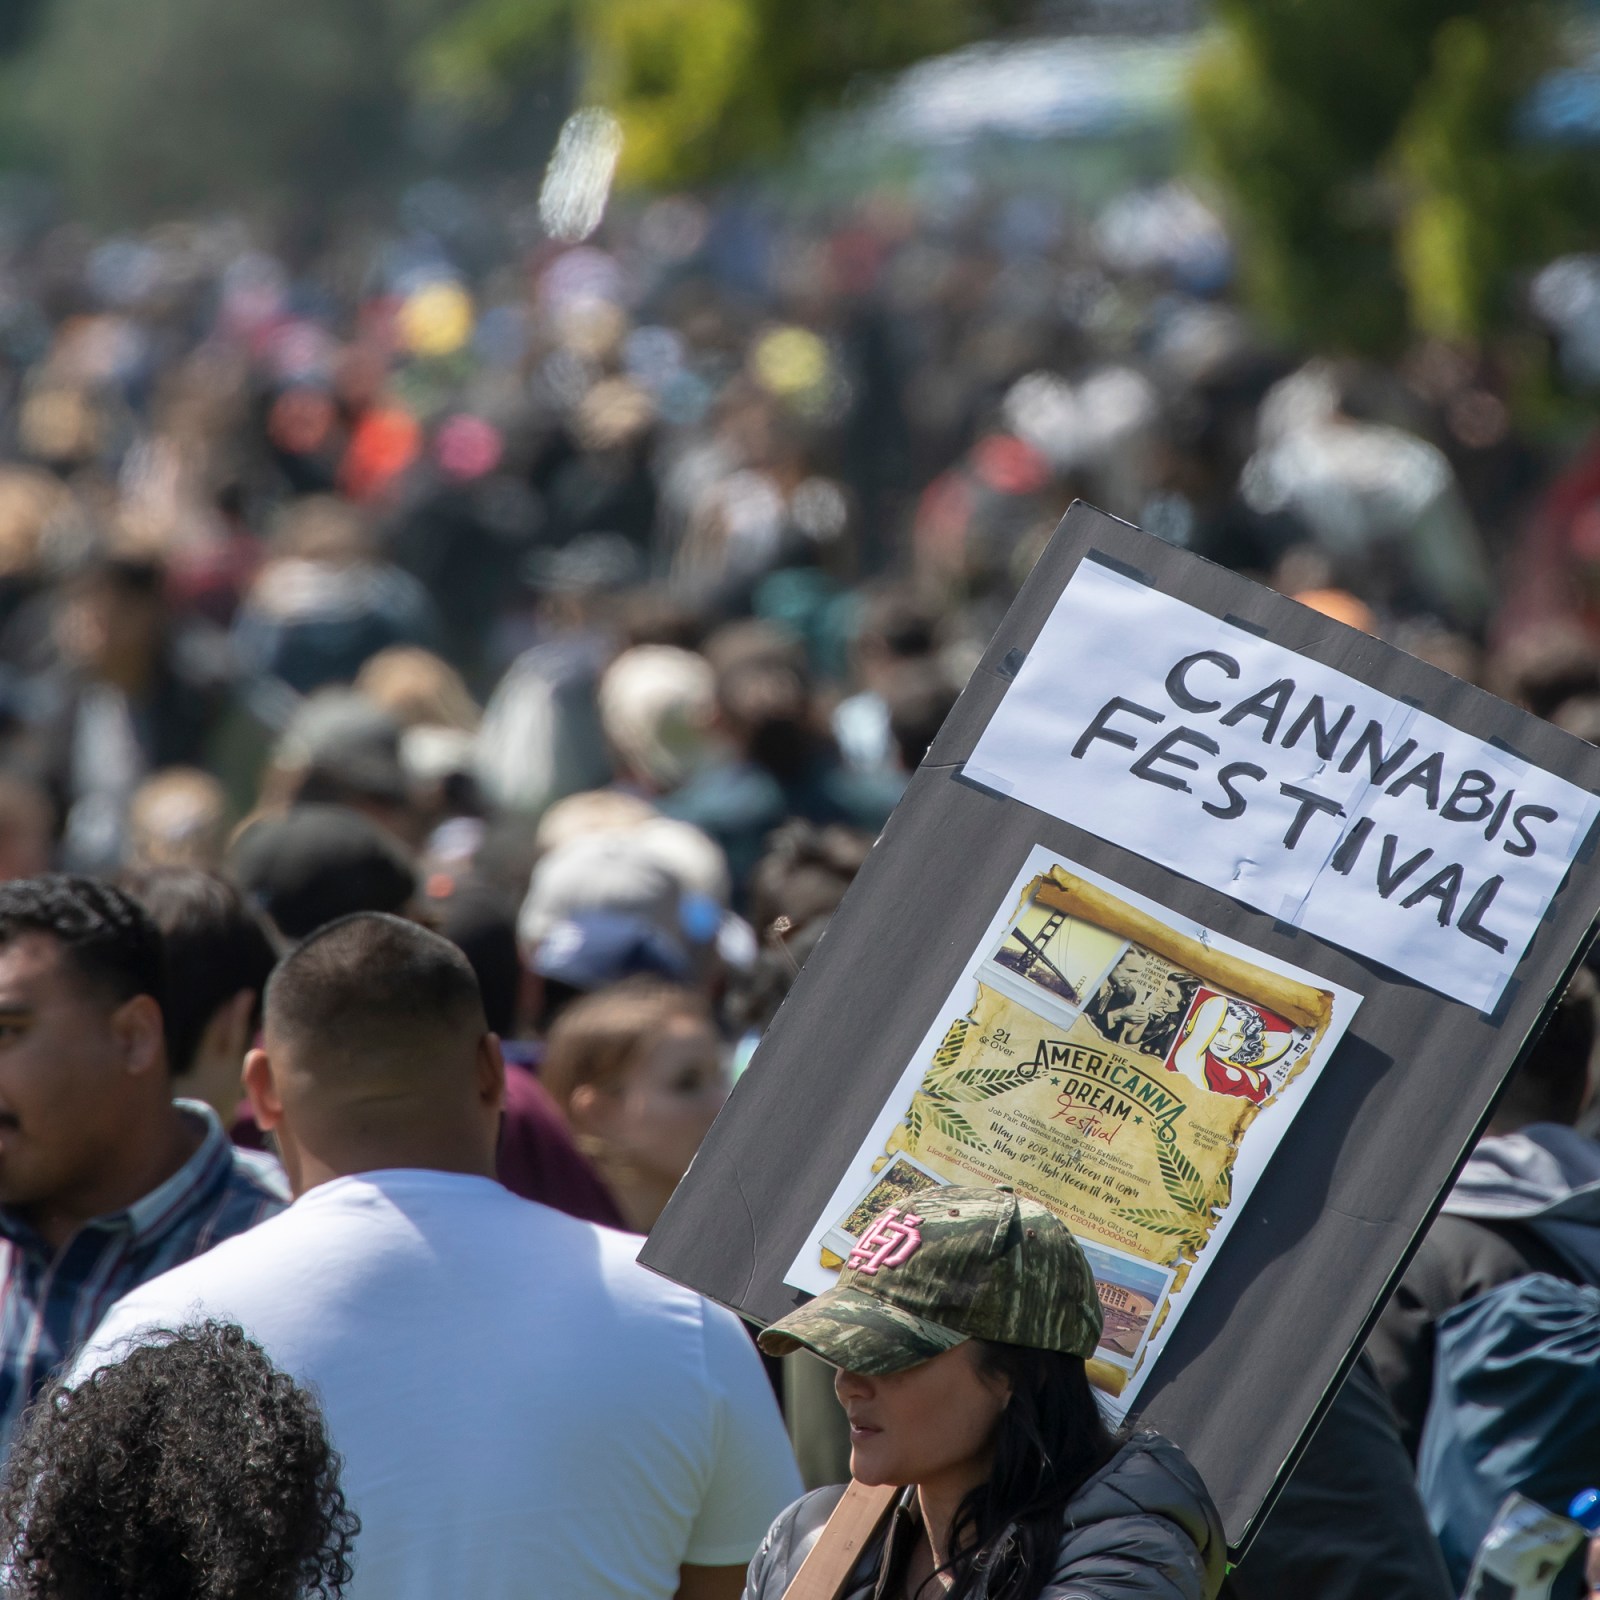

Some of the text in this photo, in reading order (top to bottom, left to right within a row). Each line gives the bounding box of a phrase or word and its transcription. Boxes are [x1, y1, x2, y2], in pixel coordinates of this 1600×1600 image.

[1164, 650, 1558, 857] CANNABIS
[1071, 696, 1509, 954] FESTIVAL
[1145, 968, 1165, 979] STARTED
[979, 1036, 1015, 1057] & Over
[993, 1028, 1011, 1044] 21
[1111, 1053, 1128, 1066] THE
[1048, 1093, 1122, 1145] Festval
[1063, 1078, 1132, 1121] DREAM
[926, 1146, 960, 1166] Licensed
[988, 1107, 1002, 1116] Job
[1020, 1121, 1051, 1140] Business
[1051, 1136, 1073, 1150] Mixer
[1082, 1151, 1097, 1161] Live
[1099, 1158, 1151, 1186] Entertainment
[990, 1121, 1013, 1141] May
[1016, 1135, 1026, 1146] 18
[1051, 1151, 1073, 1168] High
[1074, 1162, 1101, 1181] Noon
[1049, 1126, 1071, 1141] Hemp
[1080, 1141, 1096, 1152] CBD
[1097, 1149, 1134, 1169] Exhibitors
[1193, 1139, 1213, 1151] Event
[1202, 1135, 1218, 1145] Sales
[993, 1139, 1017, 1160] May
[1037, 1161, 1059, 1178] High
[1061, 1172, 1088, 1191] Noon
[954, 1148, 968, 1160] The
[969, 1156, 986, 1168] Cow
[987, 1164, 1013, 1180] Palace
[1017, 1179, 1038, 1193] 2600
[1040, 1189, 1069, 1208] Geneva
[1088, 1212, 1106, 1226] Daly
[1126, 1230, 1139, 1240] CA
